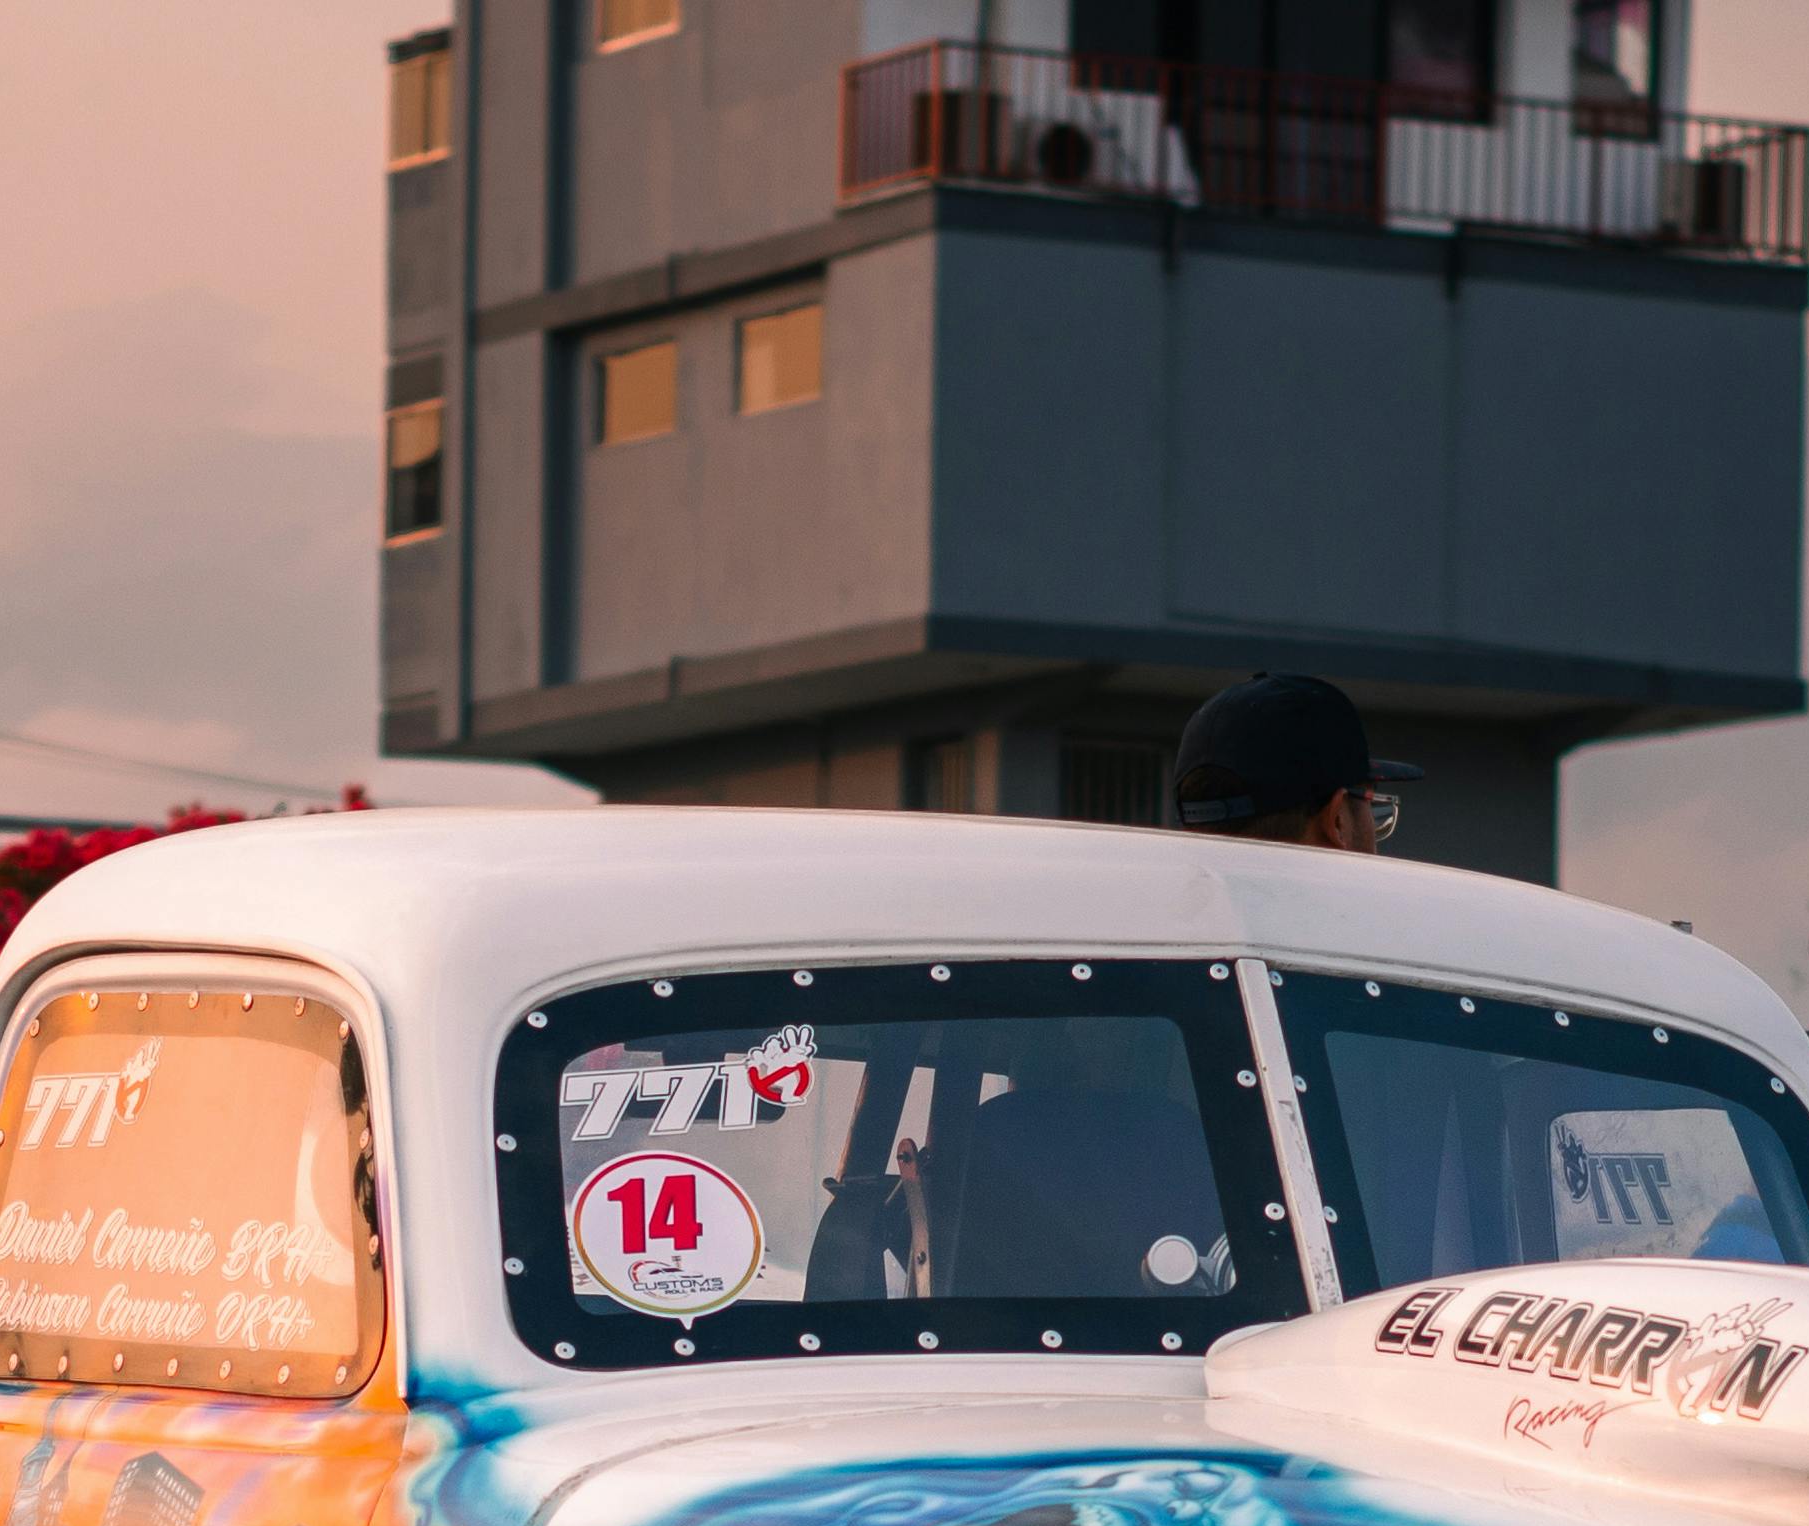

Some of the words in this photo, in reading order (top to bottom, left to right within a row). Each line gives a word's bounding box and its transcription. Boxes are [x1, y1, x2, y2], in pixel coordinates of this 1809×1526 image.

[19, 1071, 123, 1152] 771
[560, 1060, 758, 1141] 771
[607, 1174, 703, 1254] 14
[632, 1277, 724, 1292] CUSTOMS
[1375, 1287, 1465, 1356] EL
[1504, 1394, 1661, 1449] Racing
